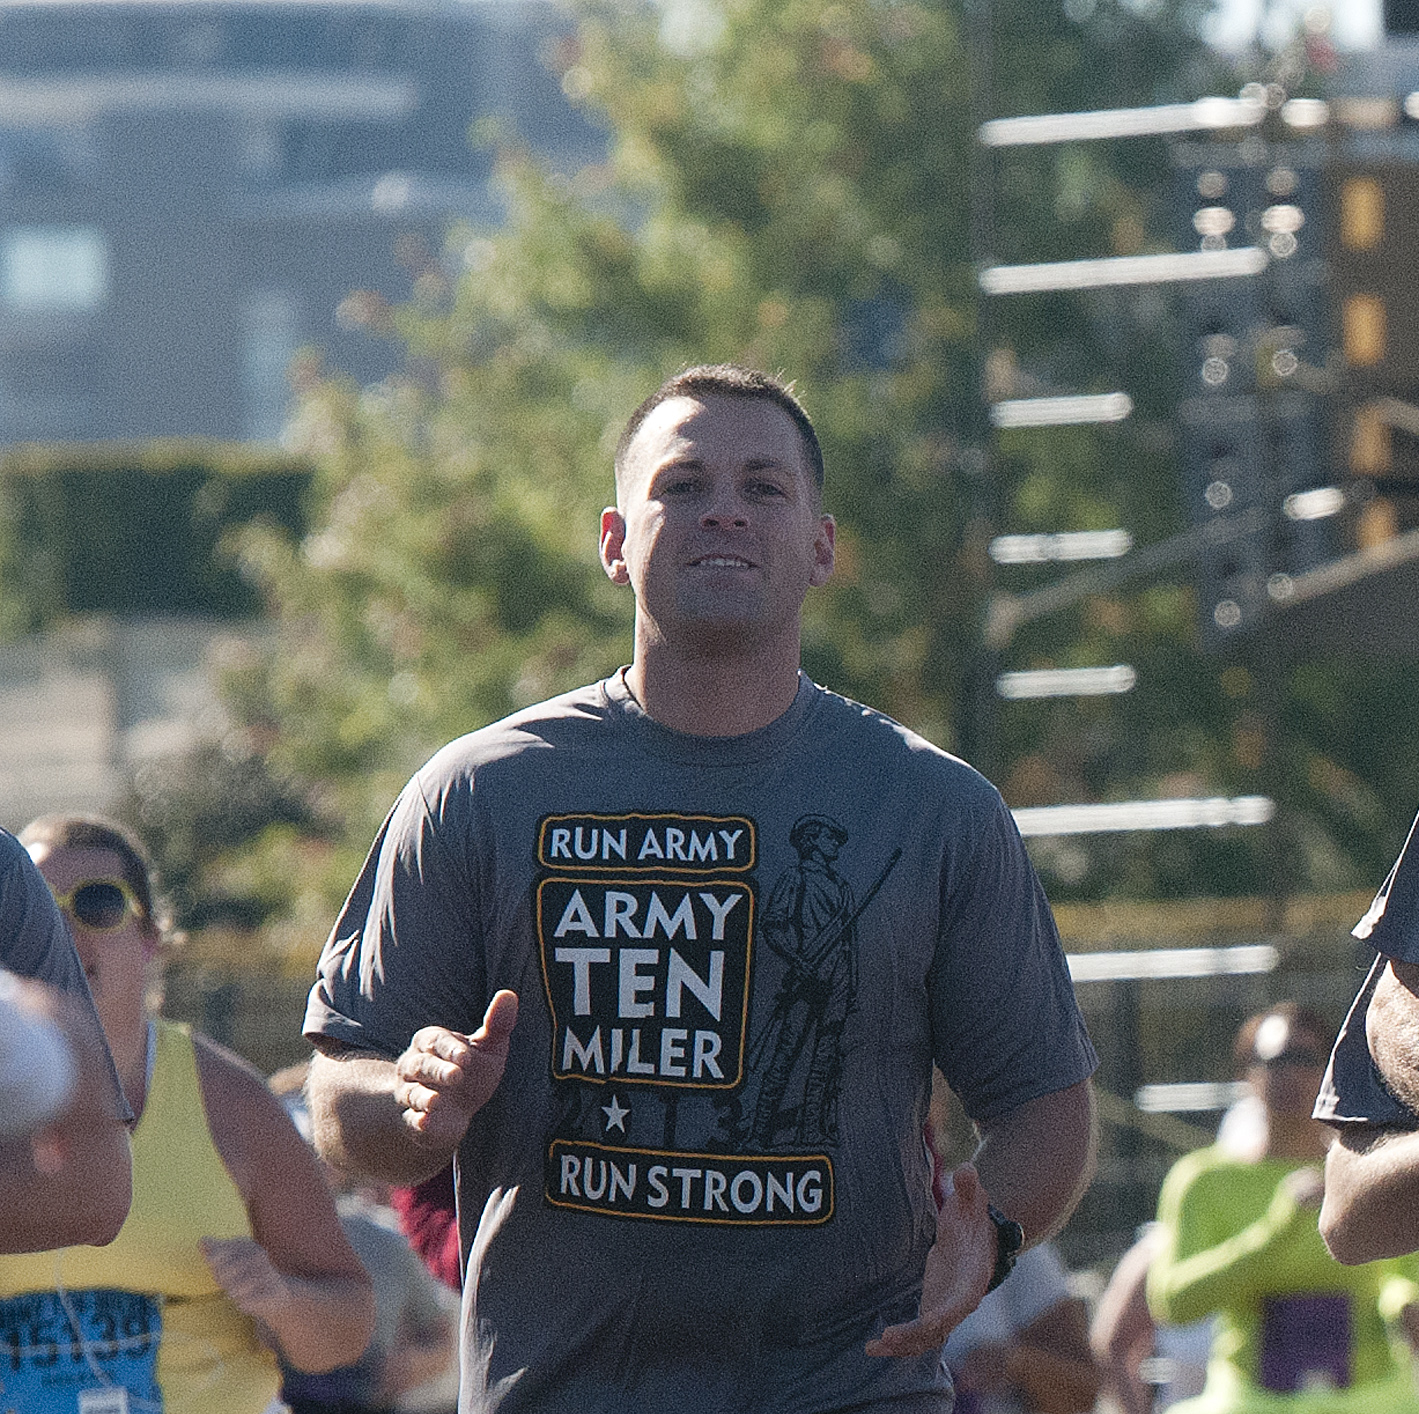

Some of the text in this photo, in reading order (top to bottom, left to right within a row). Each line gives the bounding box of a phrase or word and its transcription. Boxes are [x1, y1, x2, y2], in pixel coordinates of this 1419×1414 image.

[550, 827, 743, 862] RUN ARMY
[554, 889, 743, 941] ARMY
[554, 947, 725, 1022] TEN
[562, 1025, 724, 1080] MILER
[560, 1154, 823, 1213] RUN STRONG
